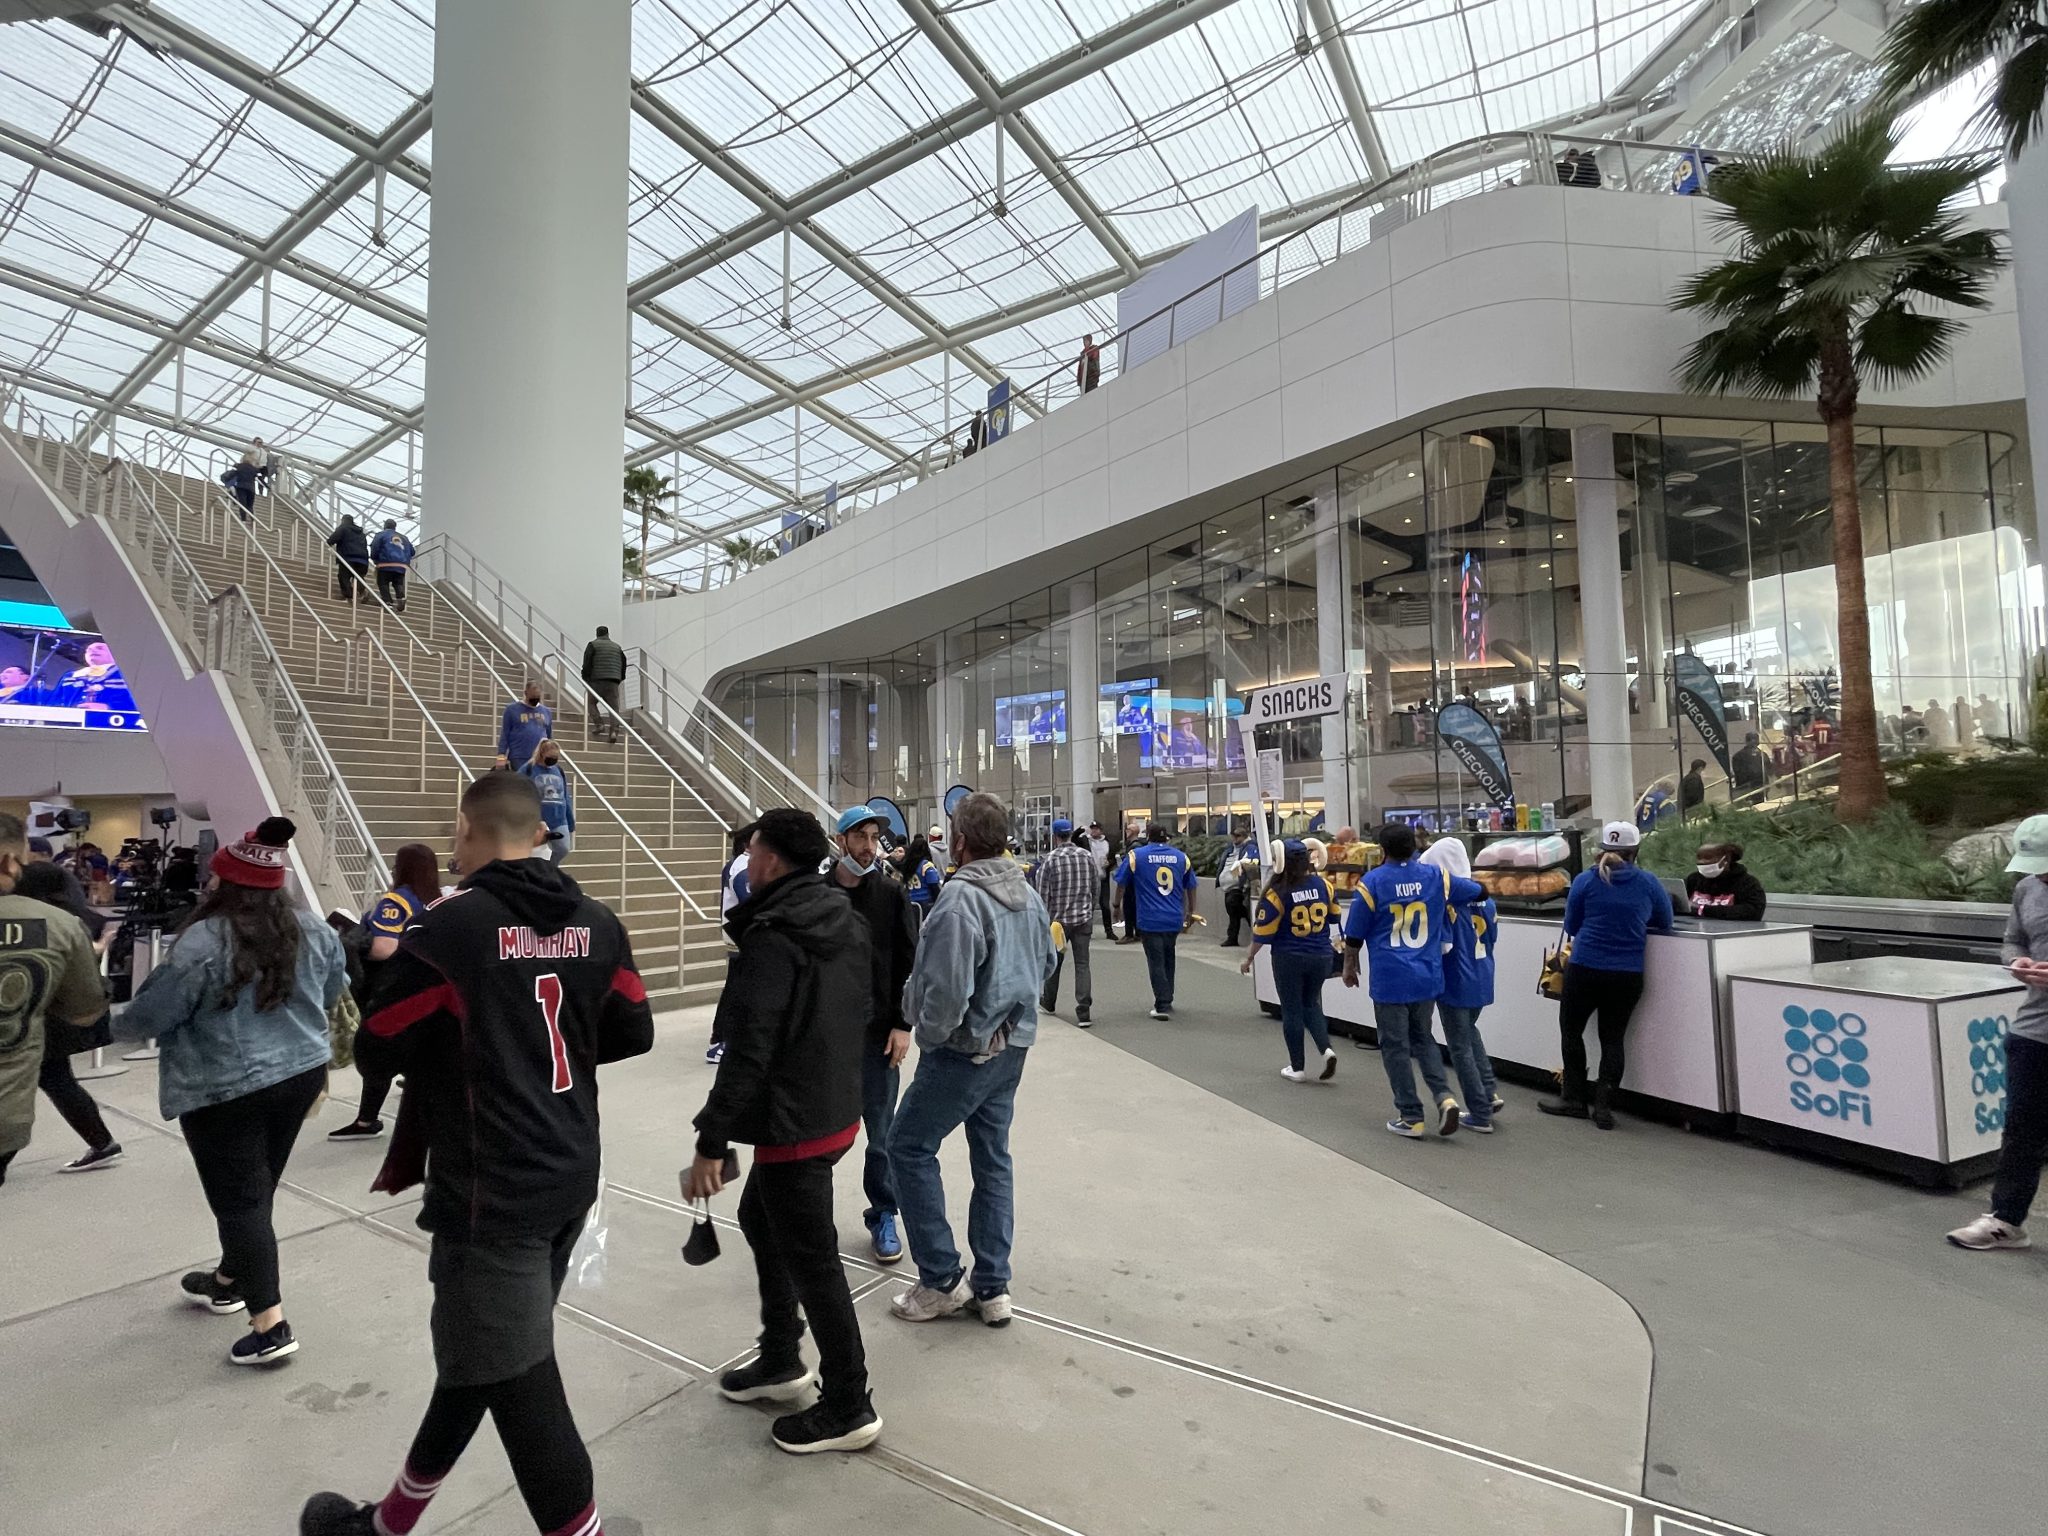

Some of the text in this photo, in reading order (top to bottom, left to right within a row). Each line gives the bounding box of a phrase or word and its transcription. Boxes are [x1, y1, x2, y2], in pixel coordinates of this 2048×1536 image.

[1262, 682, 1332, 717] SNACKS
[1679, 691, 1725, 752] CHECKOUT
[1452, 740, 1506, 801] CHECKOUT
[880, 835, 894, 851] EXIT
[1148, 855, 1178, 864] STAFFORD
[1156, 866, 1174, 896] 9
[1291, 888, 1319, 903] DONALD
[1395, 882, 1422, 897] KUPP
[381, 907, 399, 919] 30
[1291, 902, 1328, 937] 99
[1389, 901, 1428, 949] 10
[0, 923, 23, 945] D
[499, 926, 590, 960] MURRAY
[535, 973, 573, 1093] 1
[1790, 1080, 1872, 1127] SoFi
